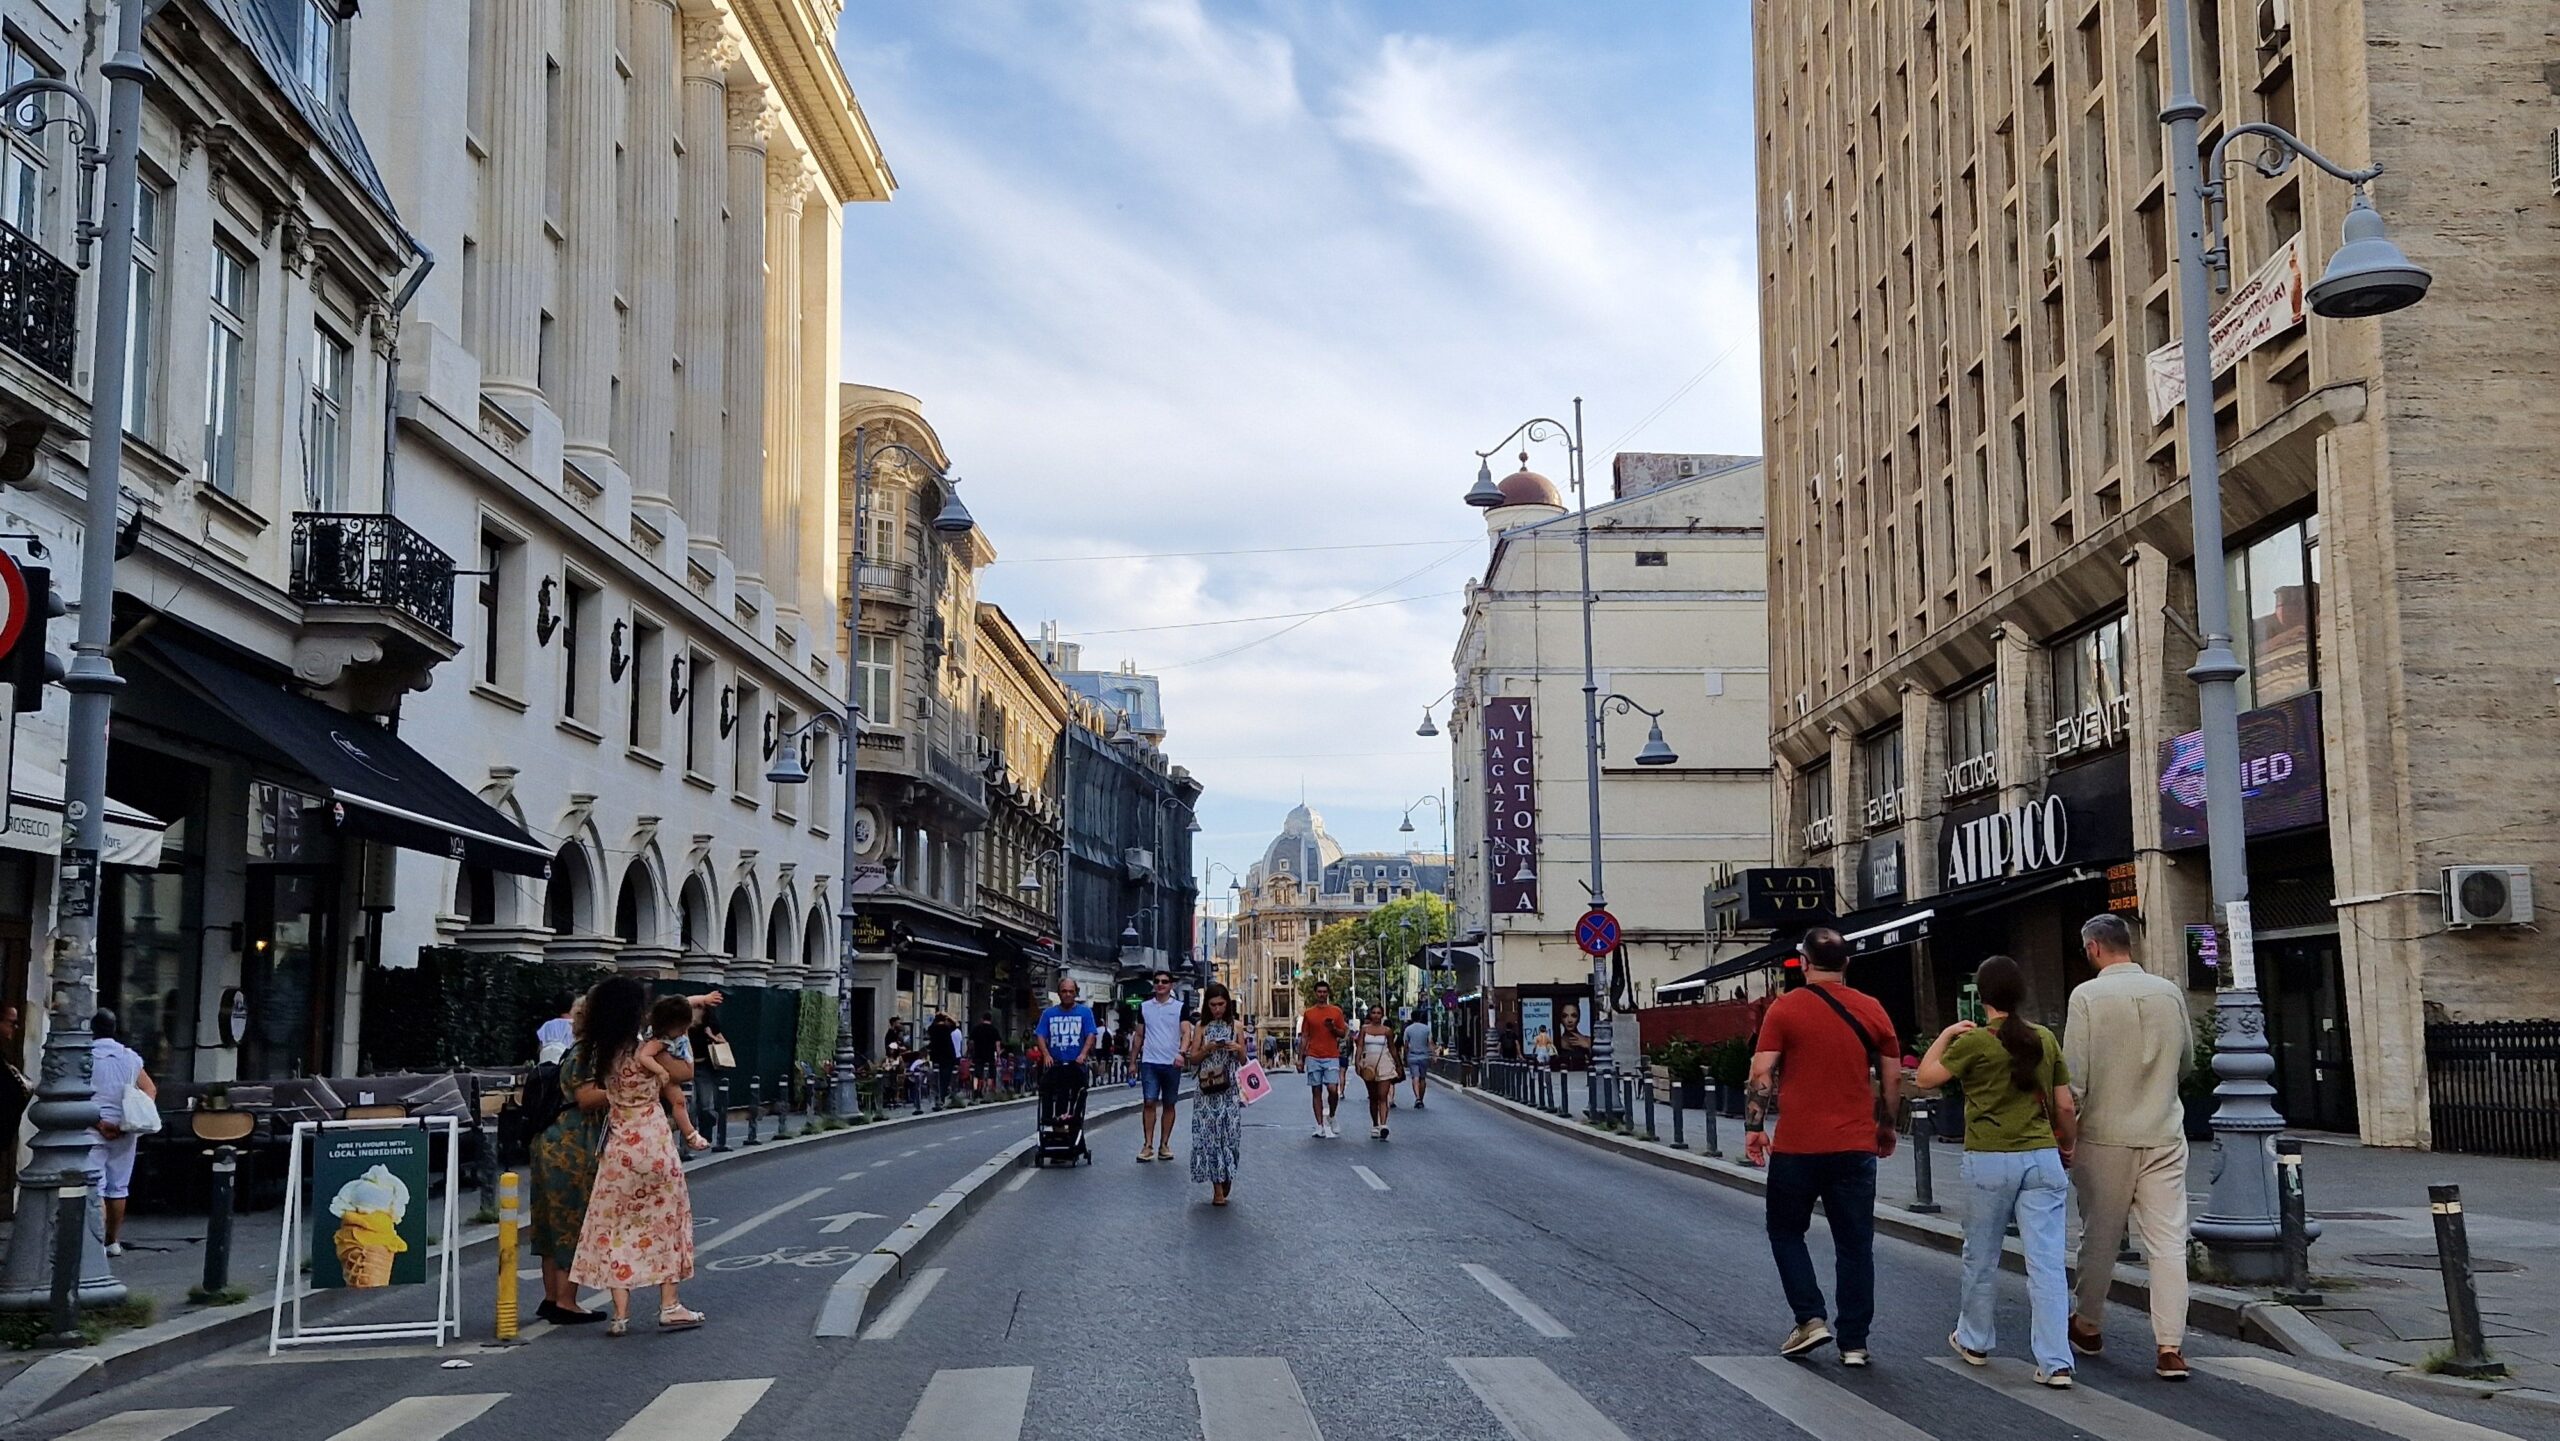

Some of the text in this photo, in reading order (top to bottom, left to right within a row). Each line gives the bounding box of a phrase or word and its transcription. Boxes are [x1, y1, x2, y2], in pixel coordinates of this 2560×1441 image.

[2240, 752, 2293, 790] IED
[1489, 728, 1506, 886] MAGAZINUL
[1510, 704, 1534, 910] VICTORA
[8, 816, 50, 838] ROSECCO
[1947, 794, 2068, 889] ATIPICO
[852, 925, 885, 936] anesha
[1049, 1021, 1082, 1036] RUN
[1050, 1035, 1080, 1048] FLEX
[328, 1147, 414, 1158] LOCAL INGREDIENTS
